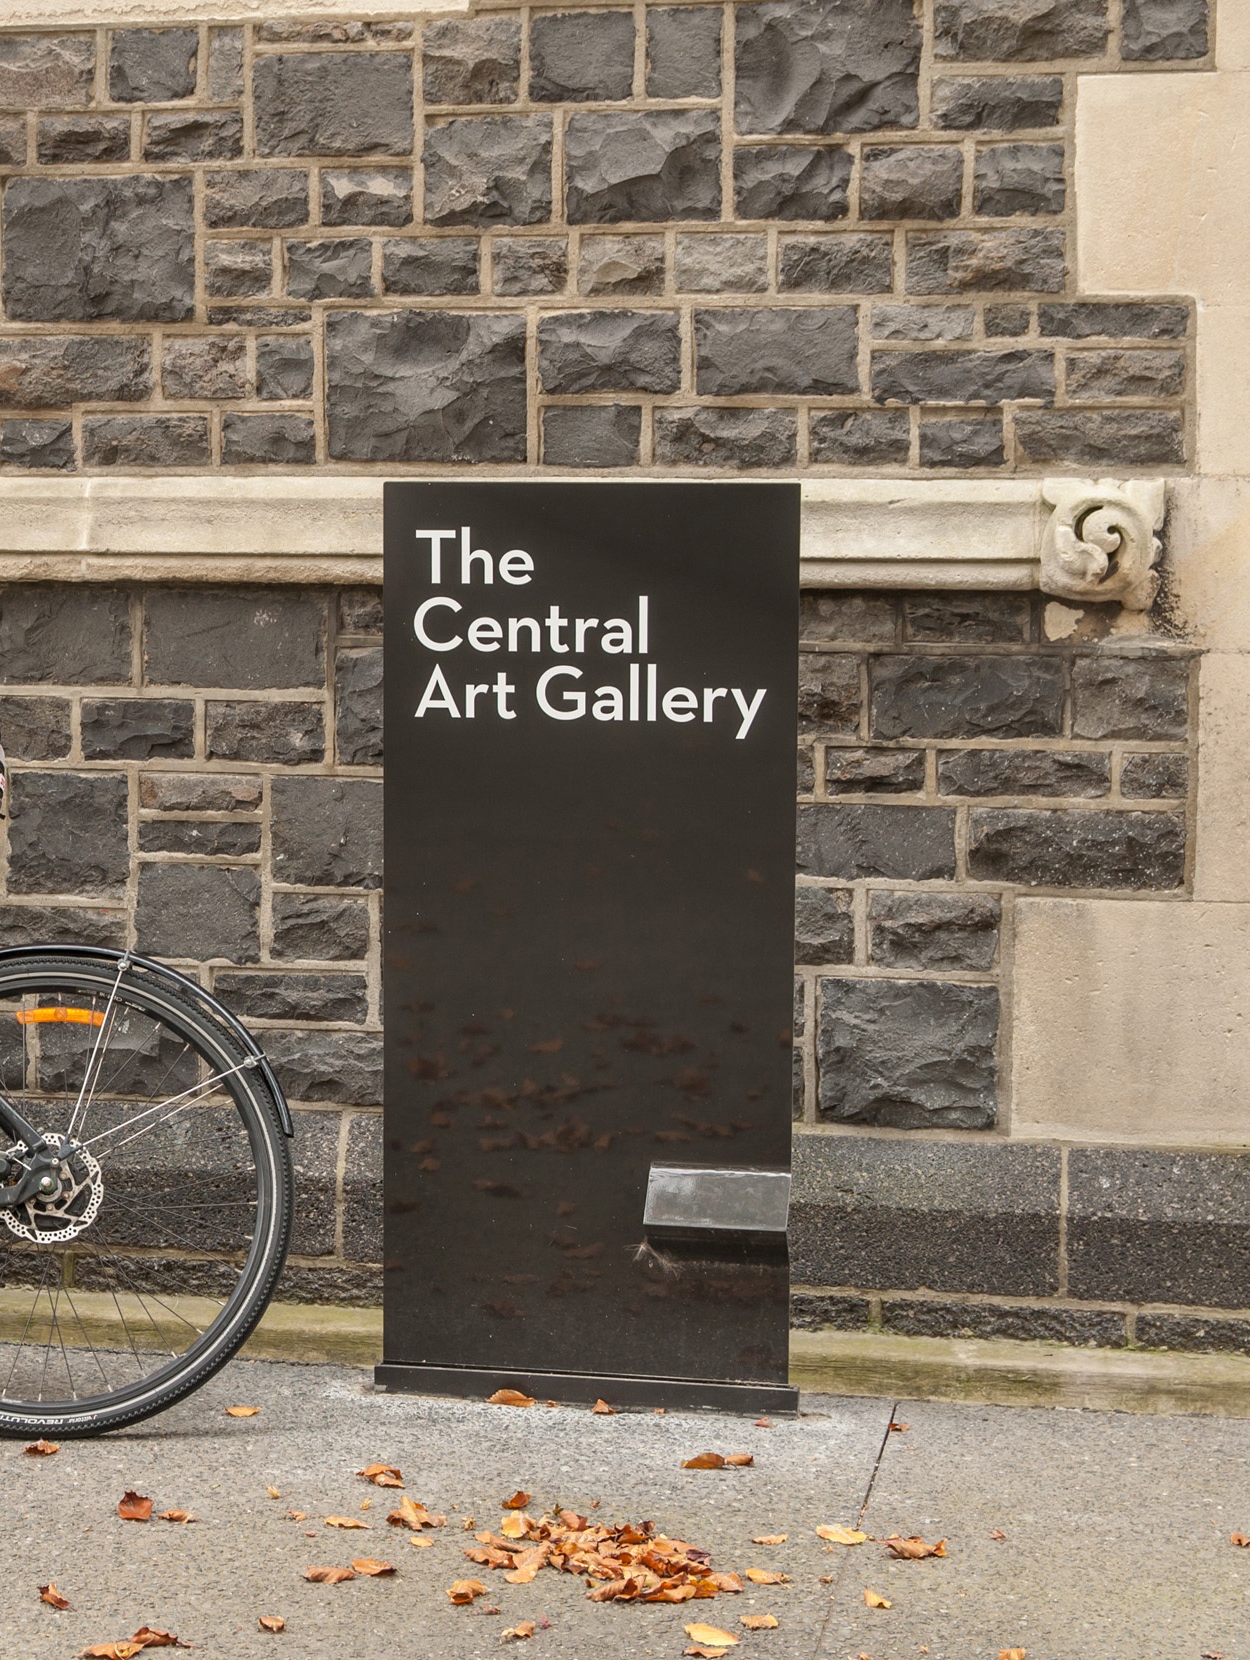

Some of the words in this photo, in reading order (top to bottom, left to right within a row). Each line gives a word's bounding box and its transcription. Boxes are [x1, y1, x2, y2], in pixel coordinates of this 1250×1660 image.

[415, 526, 535, 586] The
[413, 595, 649, 654] Central
[414, 663, 517, 720] Art
[535, 663, 767, 740] Gallery
